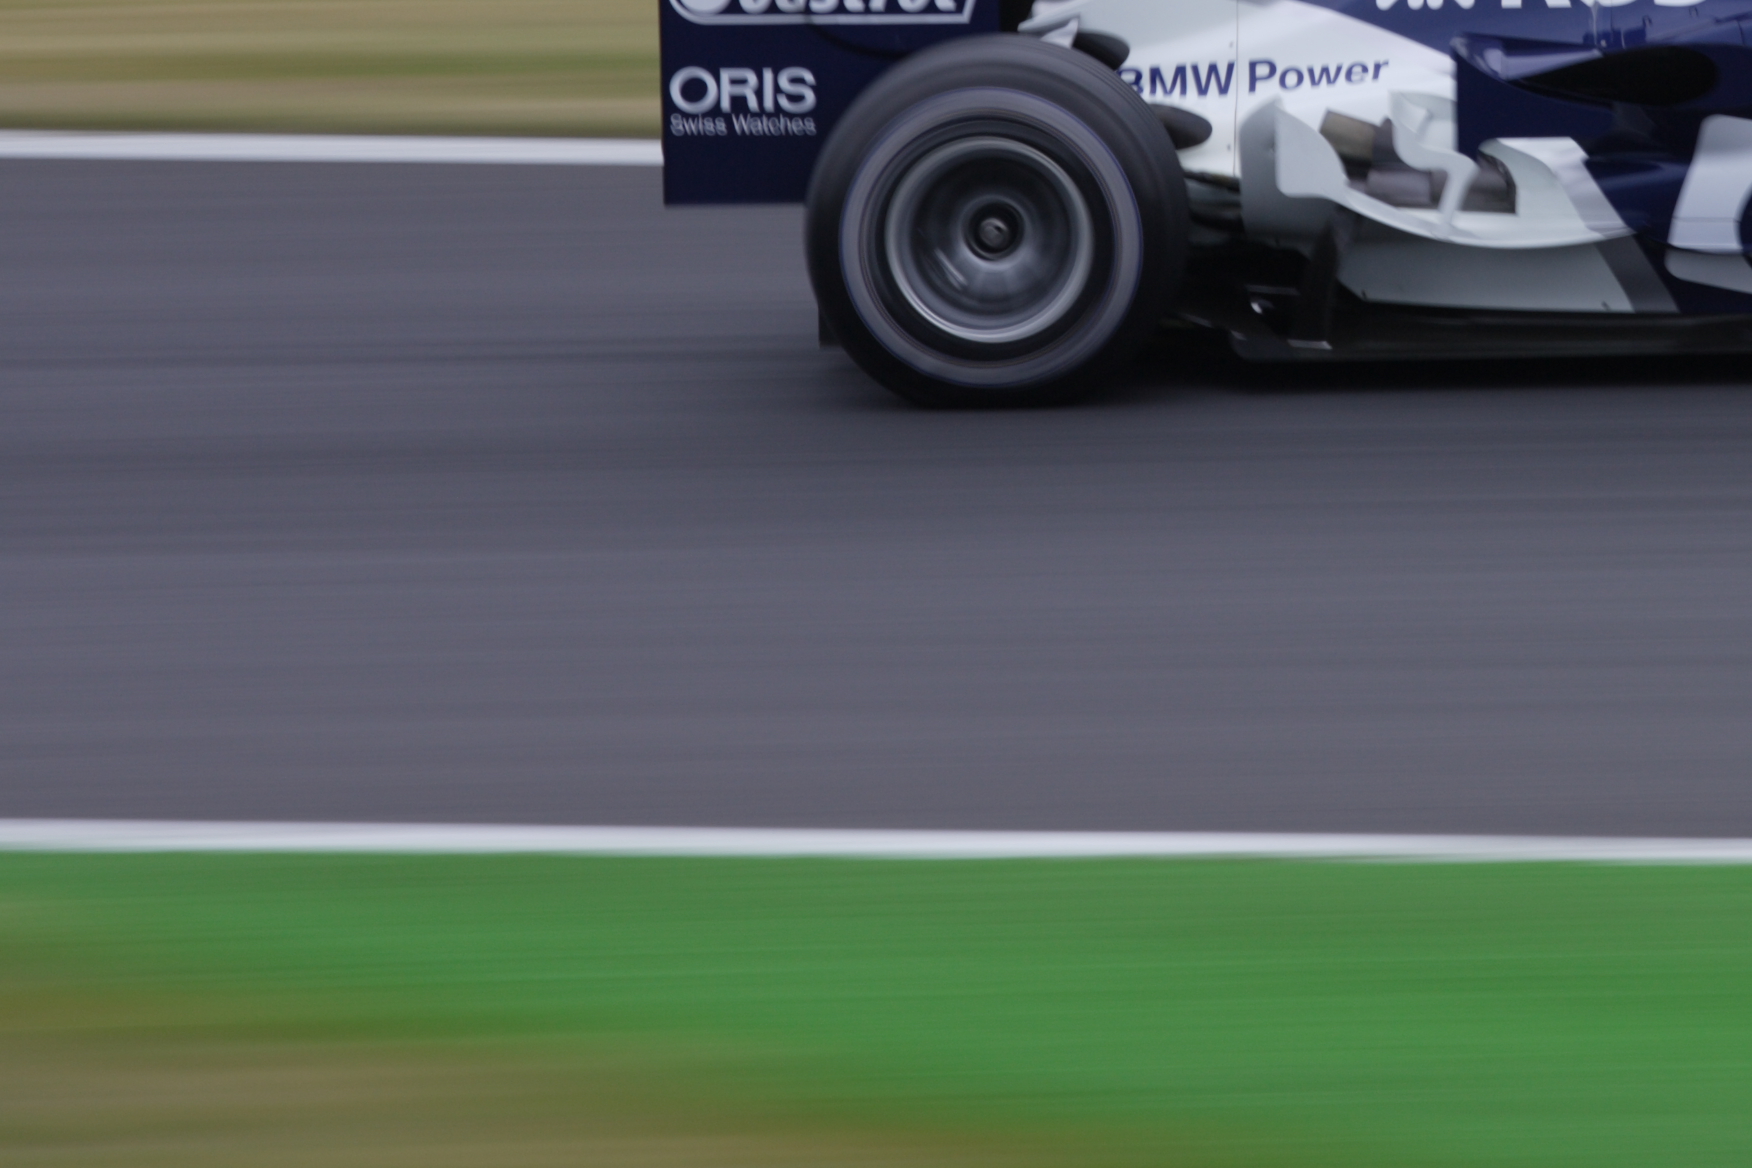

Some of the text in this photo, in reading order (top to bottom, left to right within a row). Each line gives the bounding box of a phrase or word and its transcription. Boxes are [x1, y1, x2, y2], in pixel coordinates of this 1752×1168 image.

[669, 65, 817, 114] ORIS
[1248, 57, 1390, 96] Power
[670, 113, 817, 136] Swiss Watches
